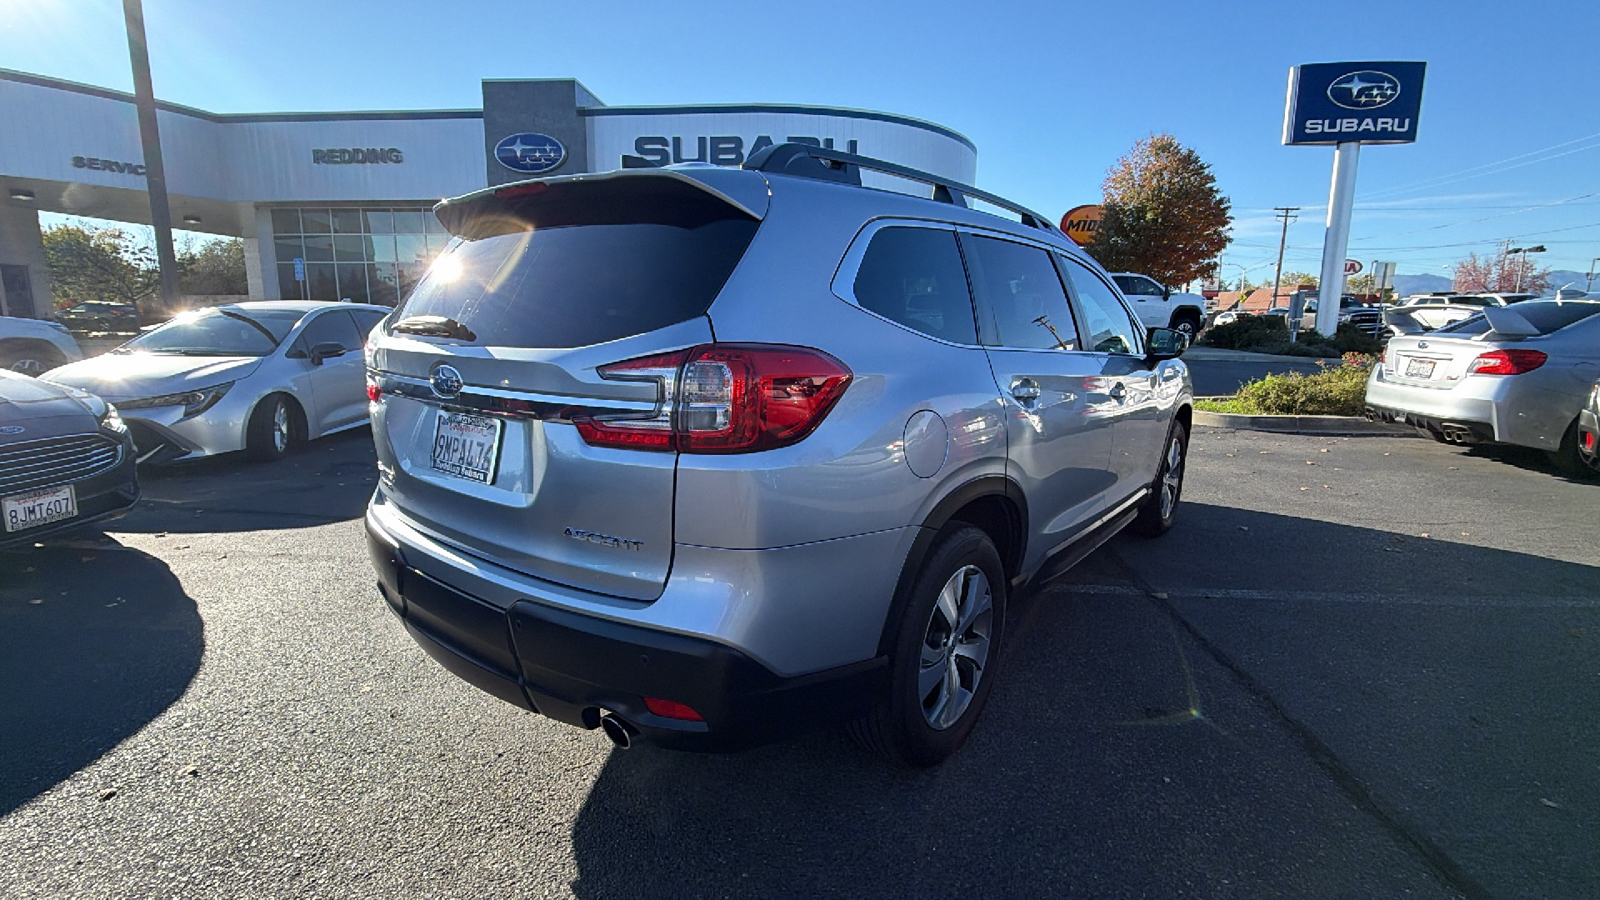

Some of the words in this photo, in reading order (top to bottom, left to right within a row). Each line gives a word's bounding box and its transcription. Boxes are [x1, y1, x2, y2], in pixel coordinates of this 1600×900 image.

[1304, 117, 1410, 134] SUBARU
[312, 147, 404, 164] REDDING
[71, 156, 147, 175] SERVIC
[1067, 219, 1099, 232] MID
[1344, 262, 1358, 273] IA
[460, 466, 484, 480] Subaru
[9, 497, 69, 525] 8JMT607
[563, 526, 644, 551] ASCENT
